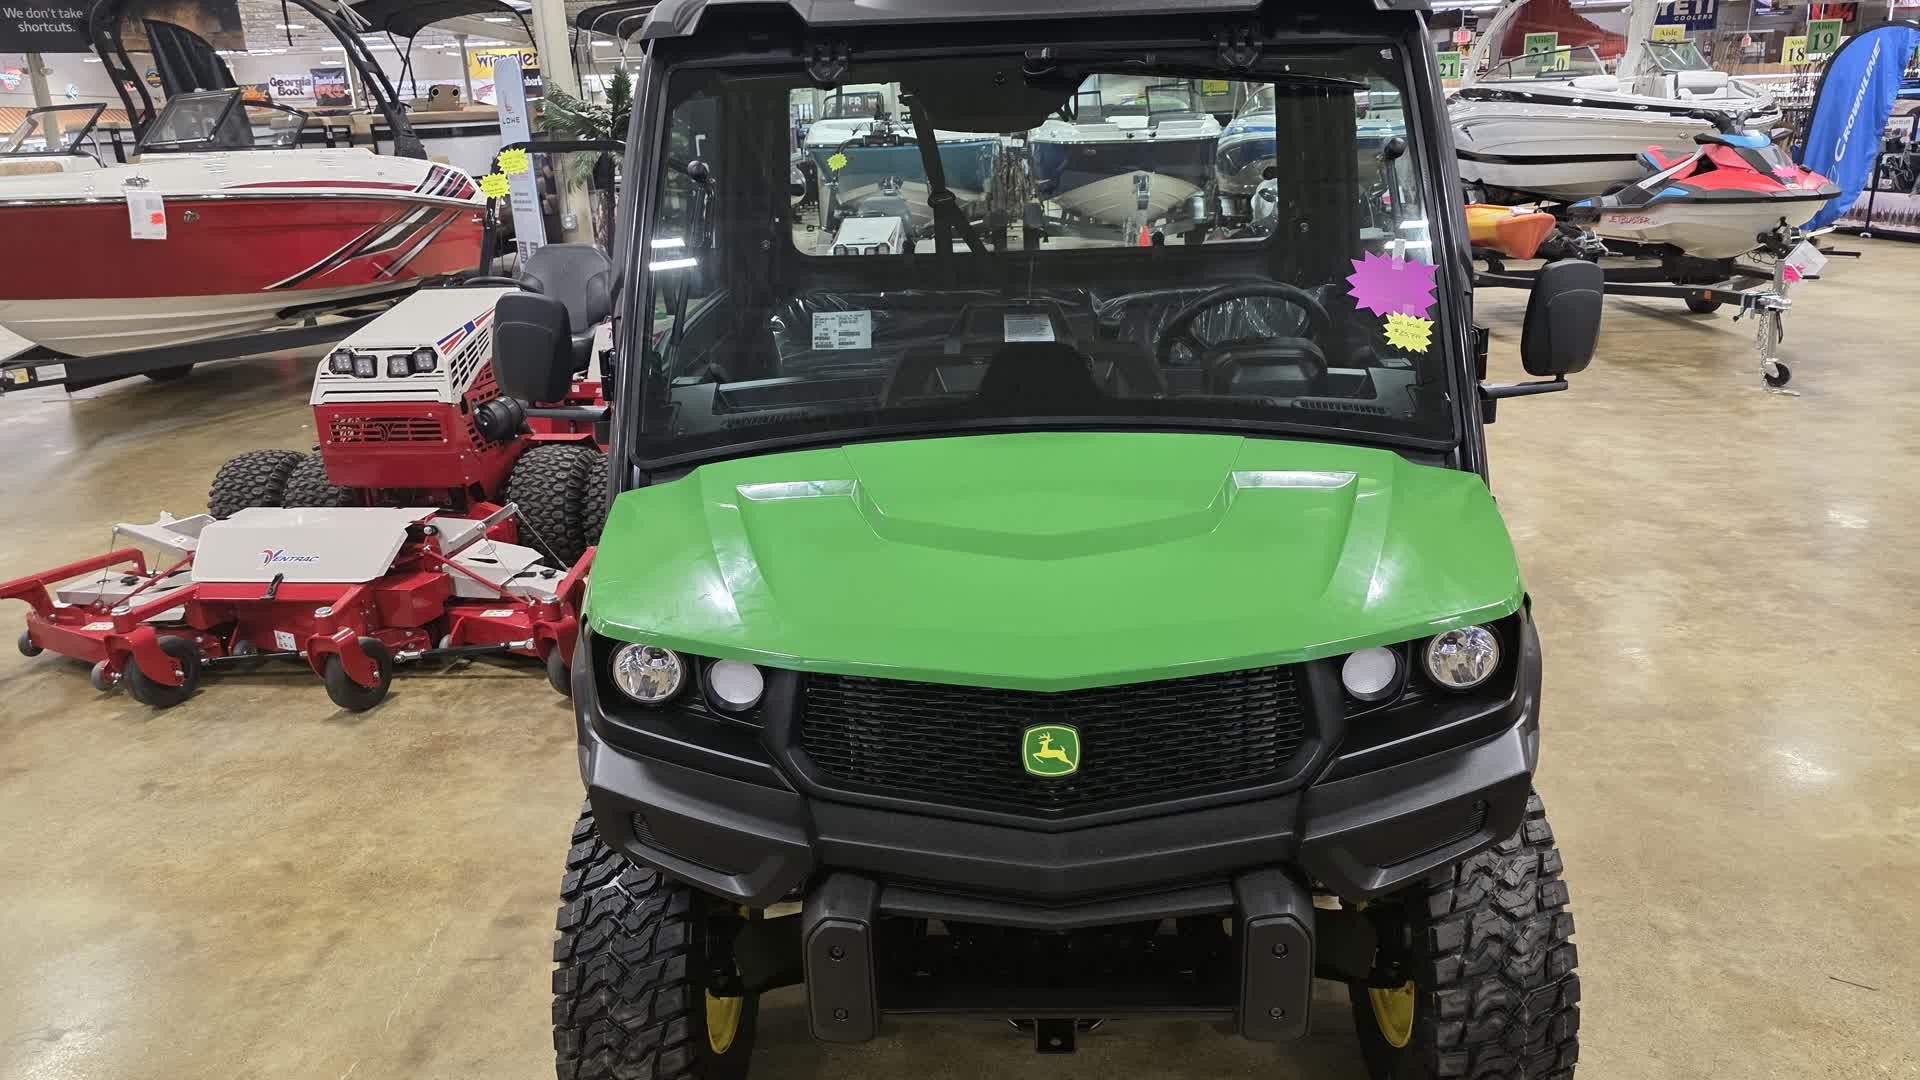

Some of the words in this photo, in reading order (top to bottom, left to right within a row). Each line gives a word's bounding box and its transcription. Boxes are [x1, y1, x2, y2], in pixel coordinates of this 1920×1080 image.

[3, 7, 23, 18] We
[26, 7, 57, 18] don't
[60, 7, 83, 18] take
[1674, 14, 1713, 22] COOLERS
[18, 21, 76, 32] shortcuts.
[1661, 29, 1677, 37] Aisle
[1813, 32, 1834, 51] 19
[1788, 47, 1805, 62] 18
[1439, 62, 1455, 77] 21
[269, 77, 312, 88] Georgia
[278, 86, 305, 96] Boot
[1834, 37, 1881, 163] CROWNLINE
[502, 116, 521, 125] LOWE
[263, 549, 320, 567] VENTRAC
